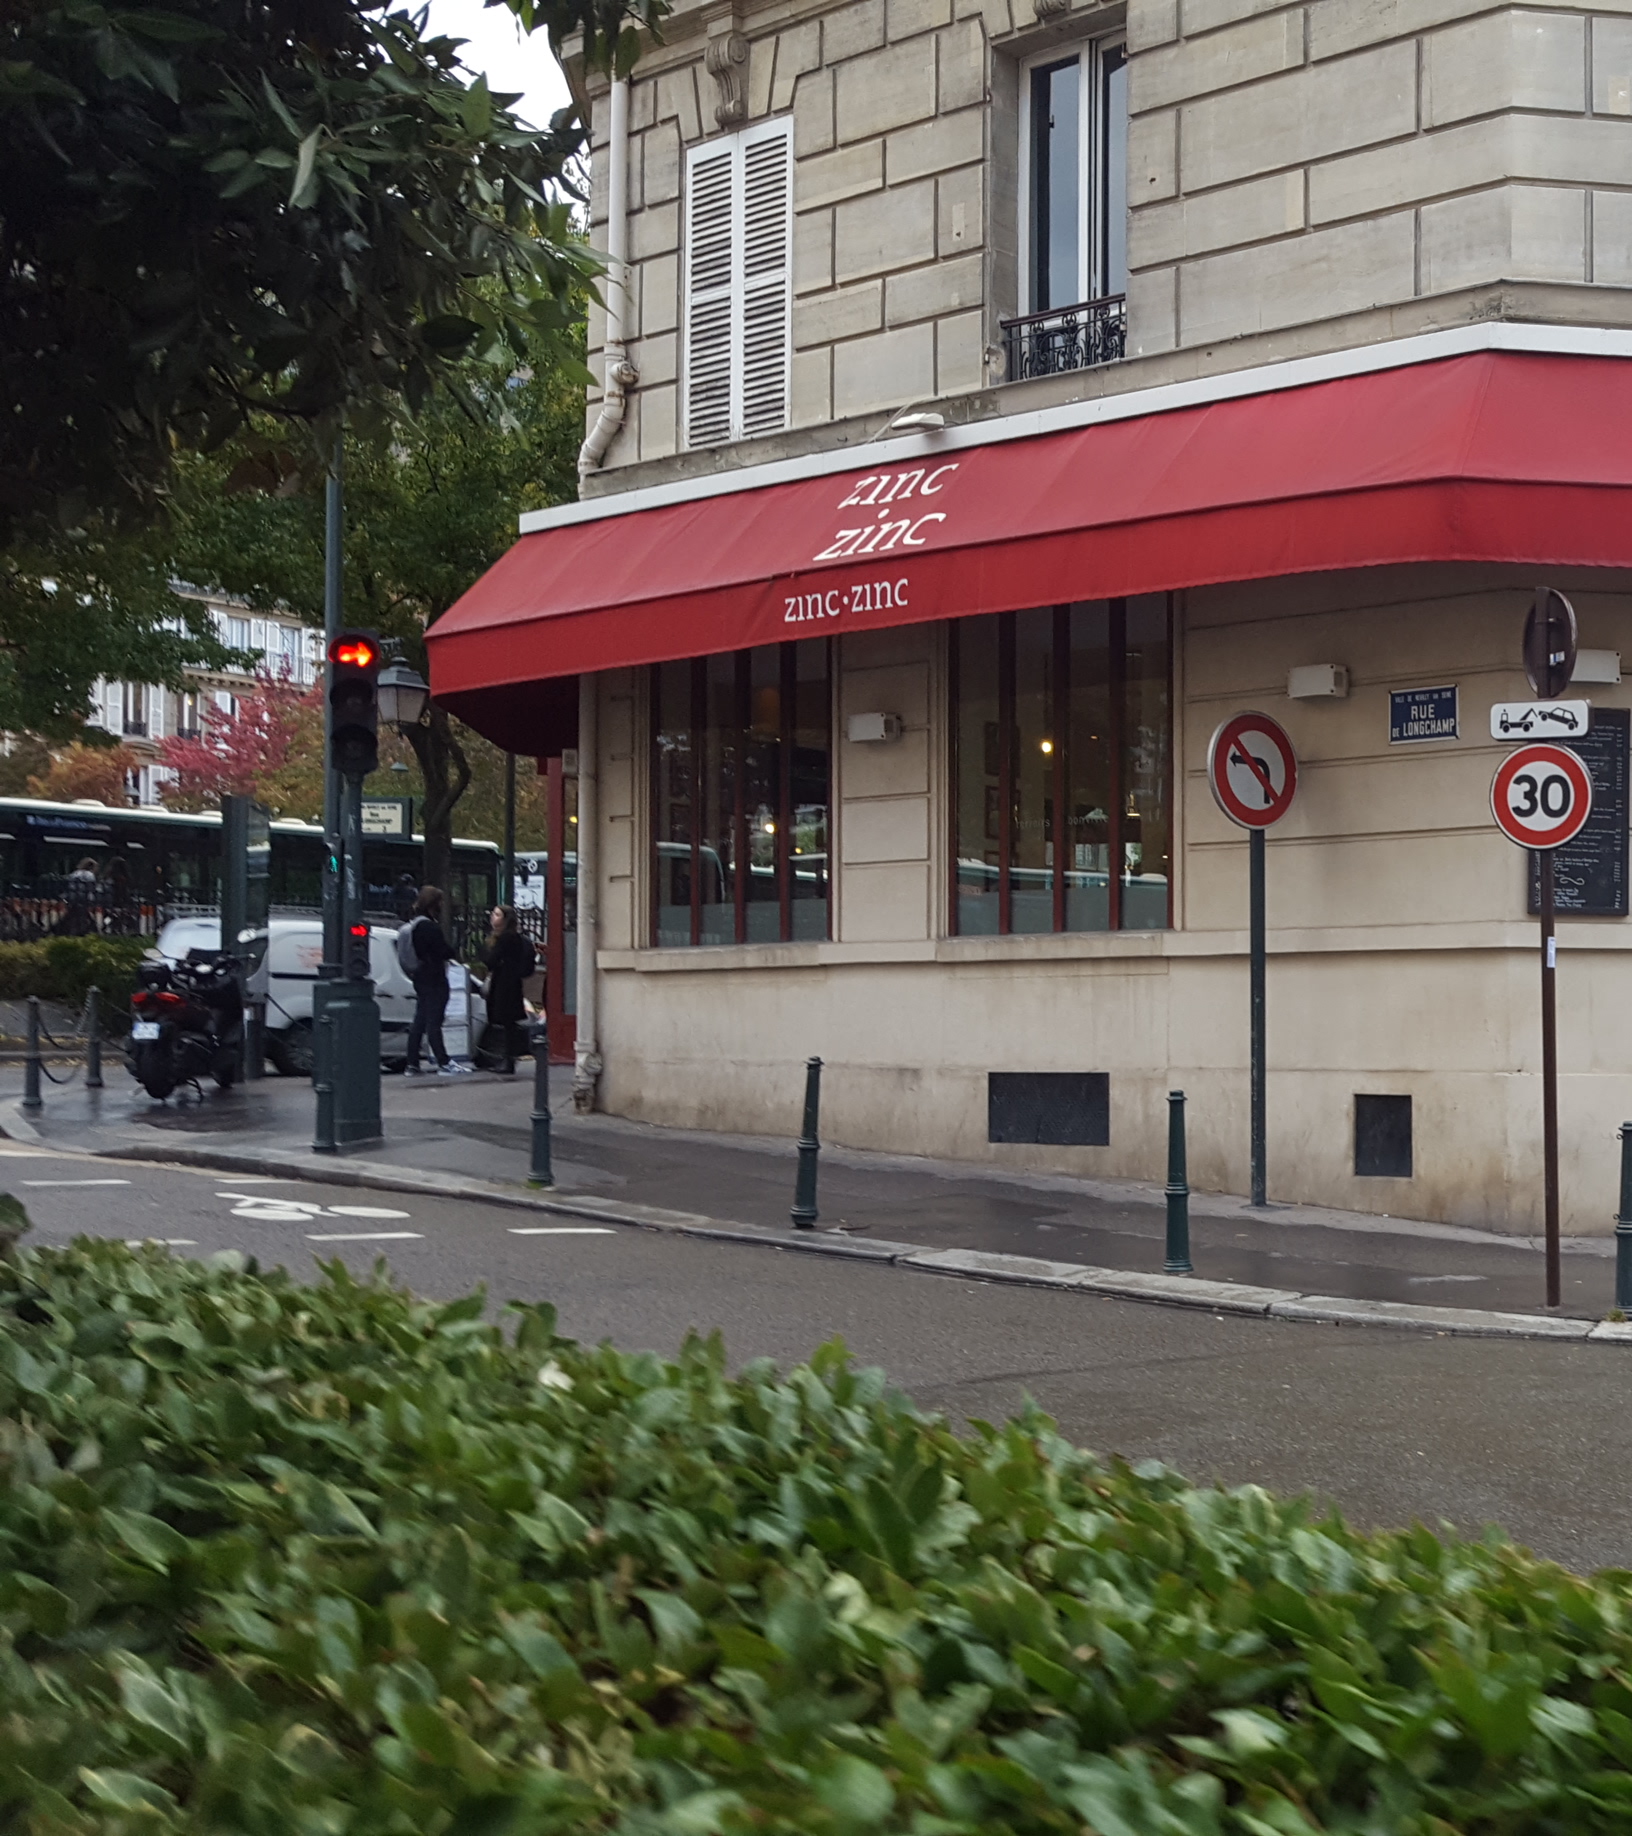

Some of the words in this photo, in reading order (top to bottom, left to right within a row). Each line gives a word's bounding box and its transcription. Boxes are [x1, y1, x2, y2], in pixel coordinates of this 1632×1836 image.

[837, 463, 961, 511] zinc
[811, 508, 948, 563] zinc
[1402, 717, 1455, 737] LONGCHAMP
[1411, 704, 1436, 720] RUE
[1511, 773, 1572, 819] 30
